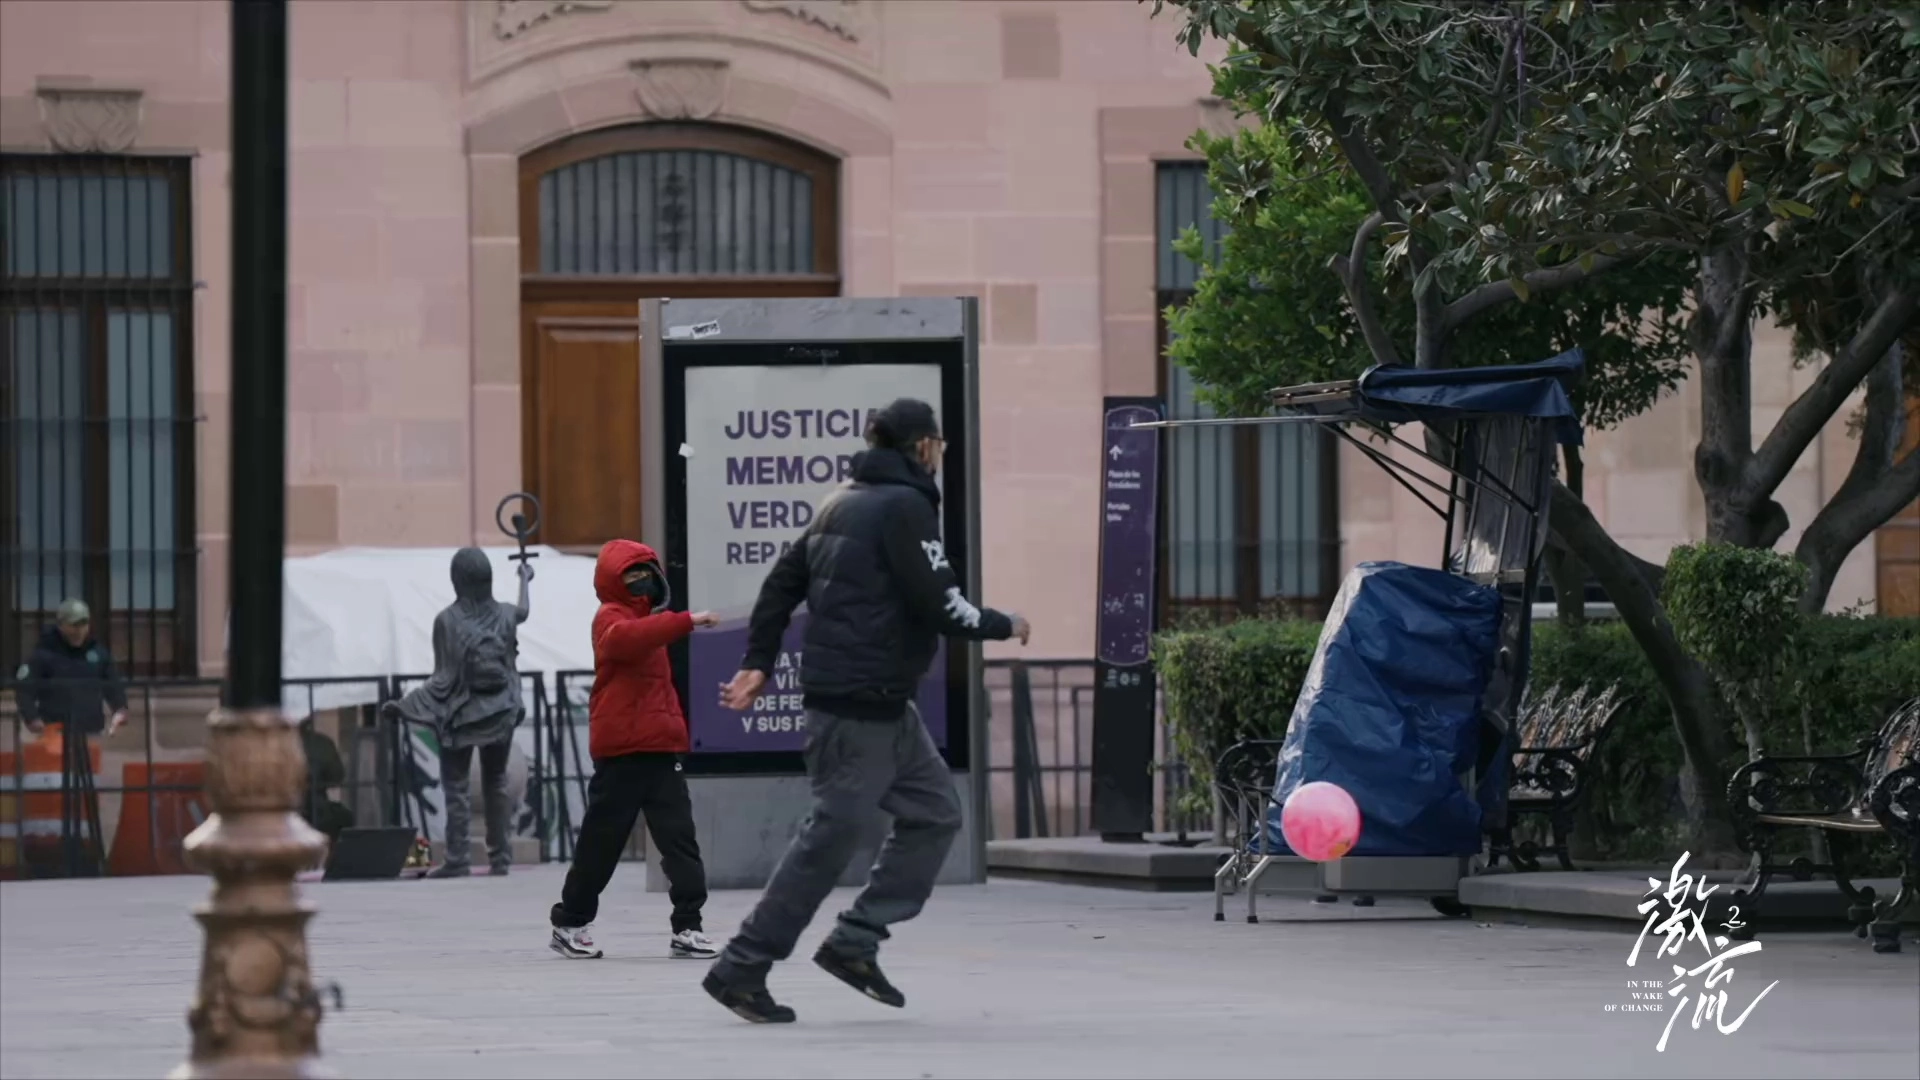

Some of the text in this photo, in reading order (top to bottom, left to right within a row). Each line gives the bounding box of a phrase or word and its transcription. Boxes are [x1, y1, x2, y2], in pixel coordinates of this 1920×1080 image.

[726, 455, 851, 485] MEMOR
[727, 501, 813, 529] VERD
[726, 541, 793, 565] REPA
[753, 694, 804, 711] DE FE
[741, 715, 808, 734] Y SUS F
